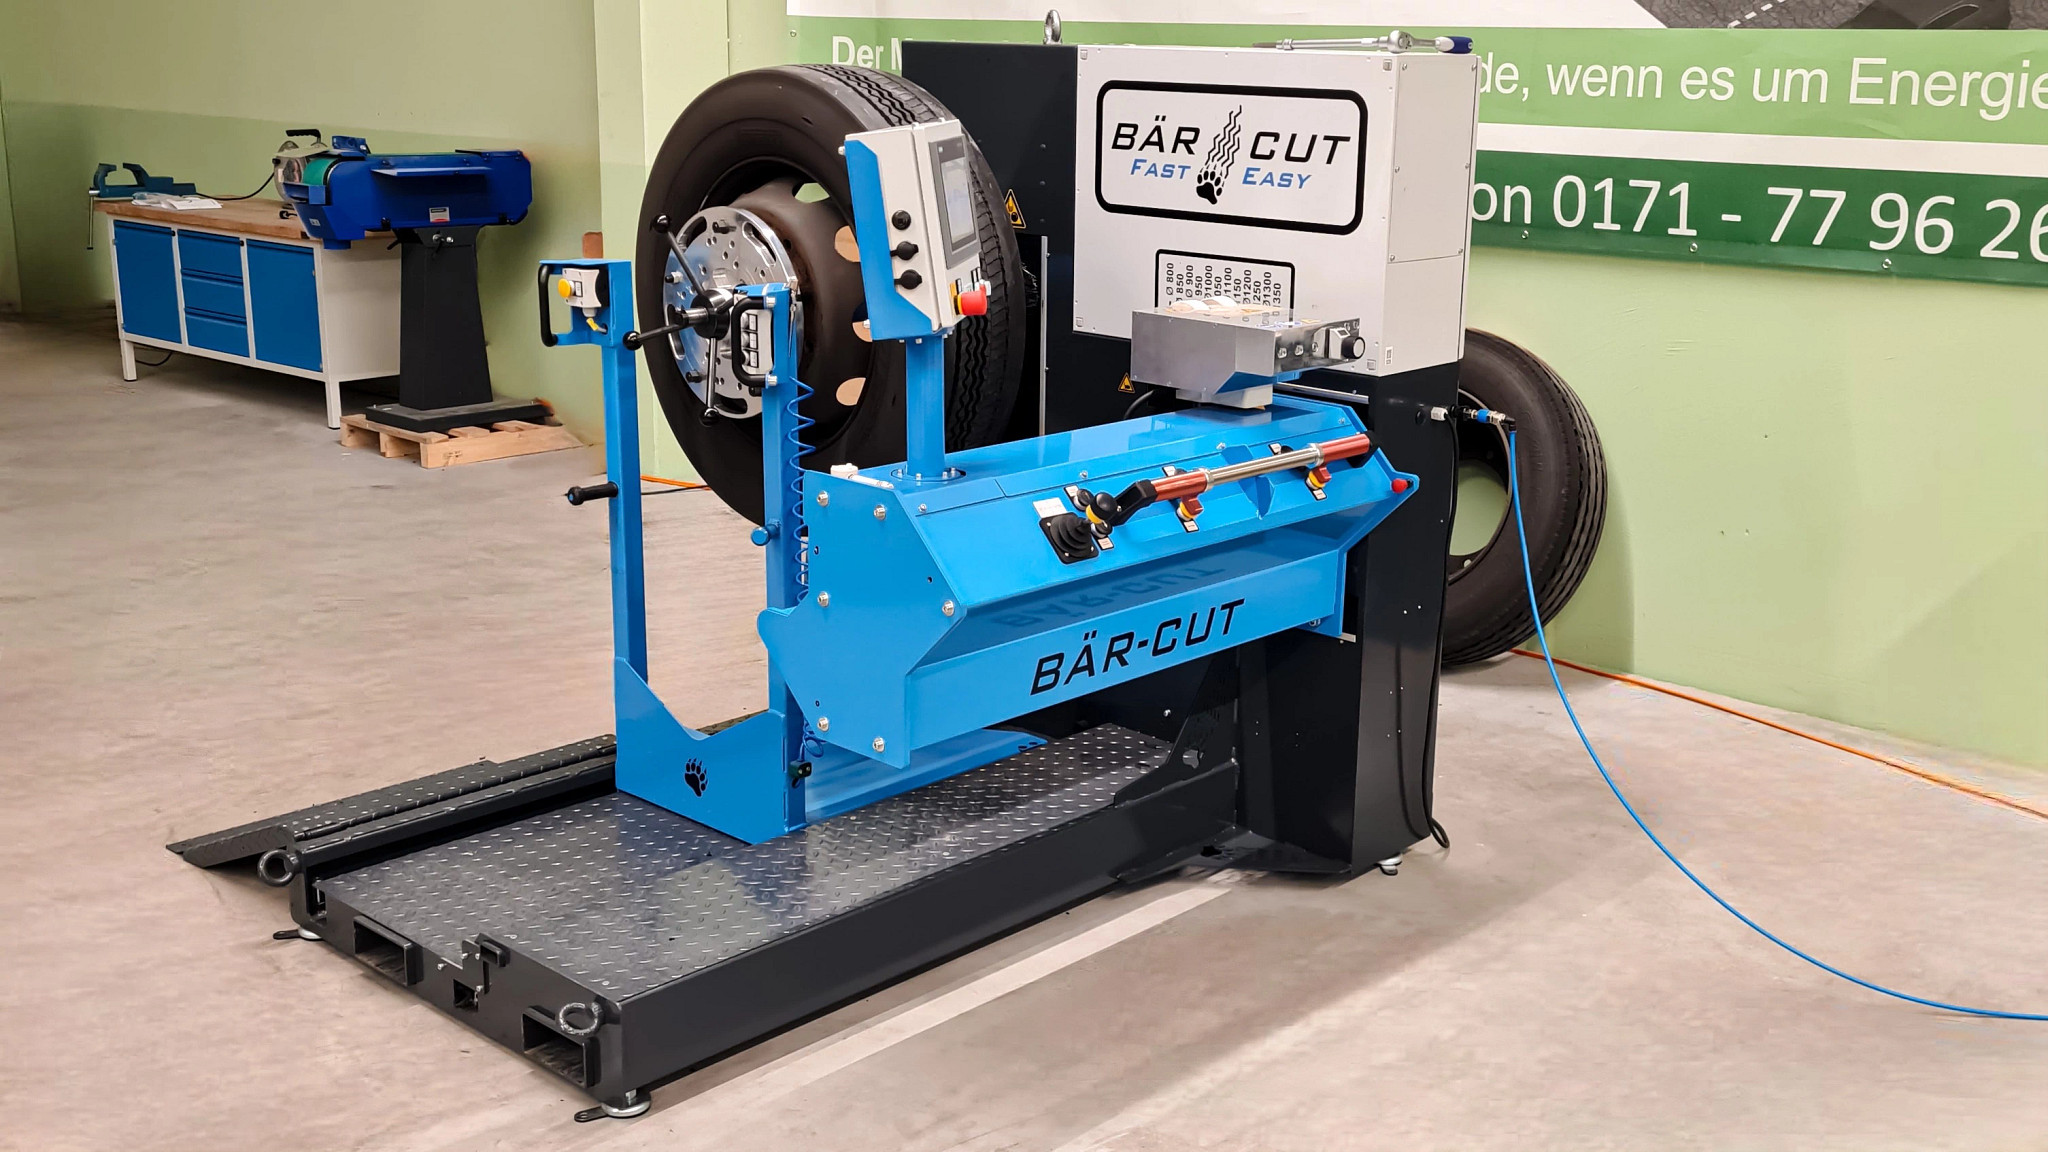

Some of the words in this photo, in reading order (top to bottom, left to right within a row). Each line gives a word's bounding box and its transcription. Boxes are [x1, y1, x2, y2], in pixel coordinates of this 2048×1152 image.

[832, 36, 884, 69] Der
[1480, 51, 1530, 102] de,
[1546, 63, 1663, 98] wenn
[1680, 65, 1736, 101] es
[1752, 67, 1829, 103] um
[1111, 115, 1201, 155] BÄR
[1249, 131, 1352, 165] CUT
[1471, 182, 1532, 224] on
[1553, 175, 1698, 236] 0171
[1767, 186, 1847, 246] 77
[1869, 192, 1956, 254] 96
[1166, 262, 1174, 283] 800
[1176, 273, 1184, 294] 850
[1185, 264, 1194, 285] 900
[1194, 275, 1203, 296] 950
[1213, 276, 1222, 297] 050
[1223, 267, 1232, 298] 1100
[1030, 598, 1246, 696] BÄR-CUT
